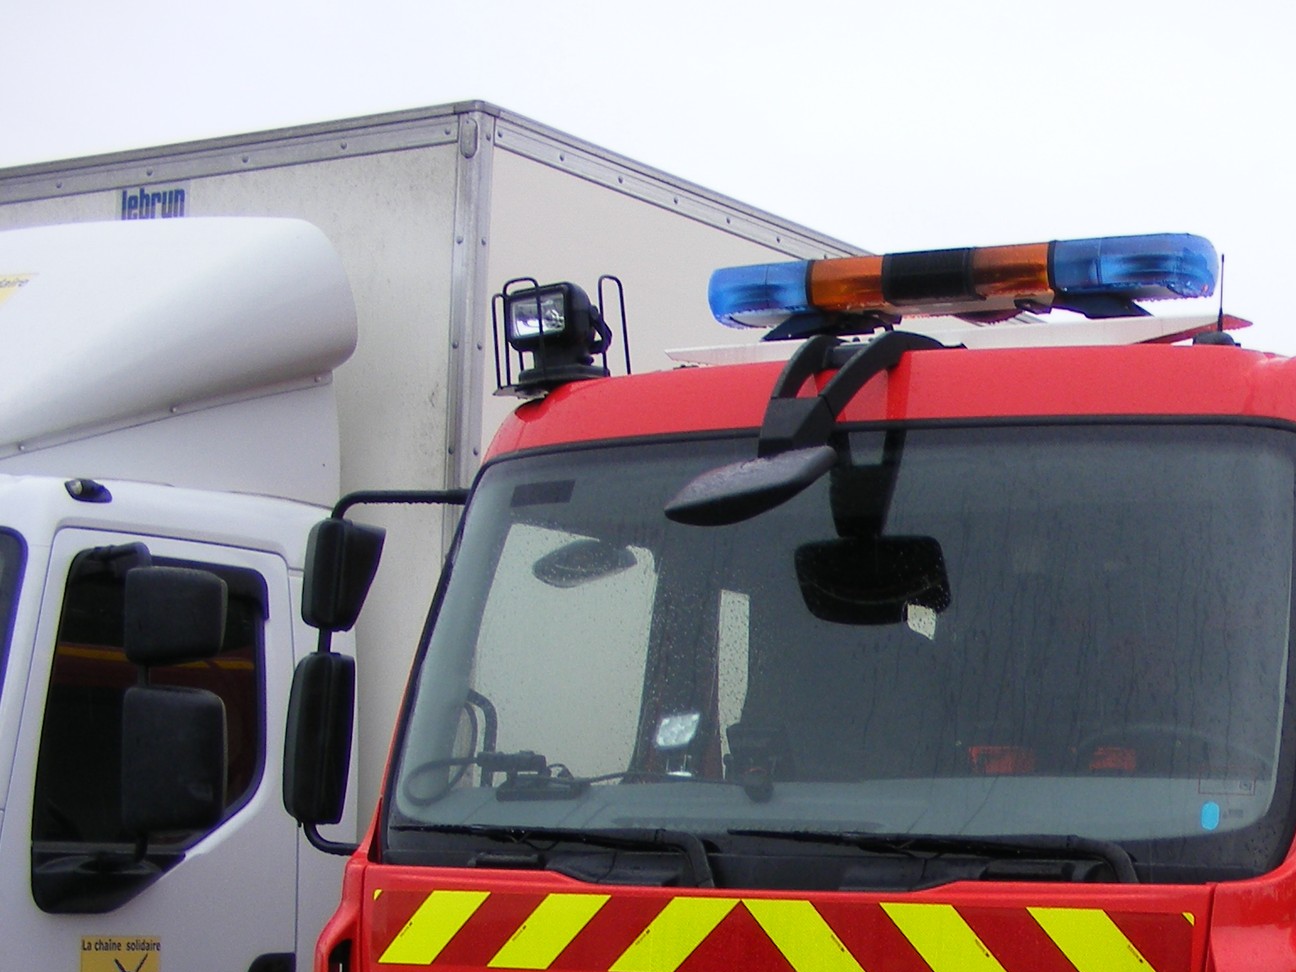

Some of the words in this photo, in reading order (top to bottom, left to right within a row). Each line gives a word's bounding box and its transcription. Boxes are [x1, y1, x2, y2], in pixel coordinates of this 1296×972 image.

[121, 187, 186, 220] lebrun
[82, 939, 92, 951] La
[126, 939, 160, 951] solidaire
